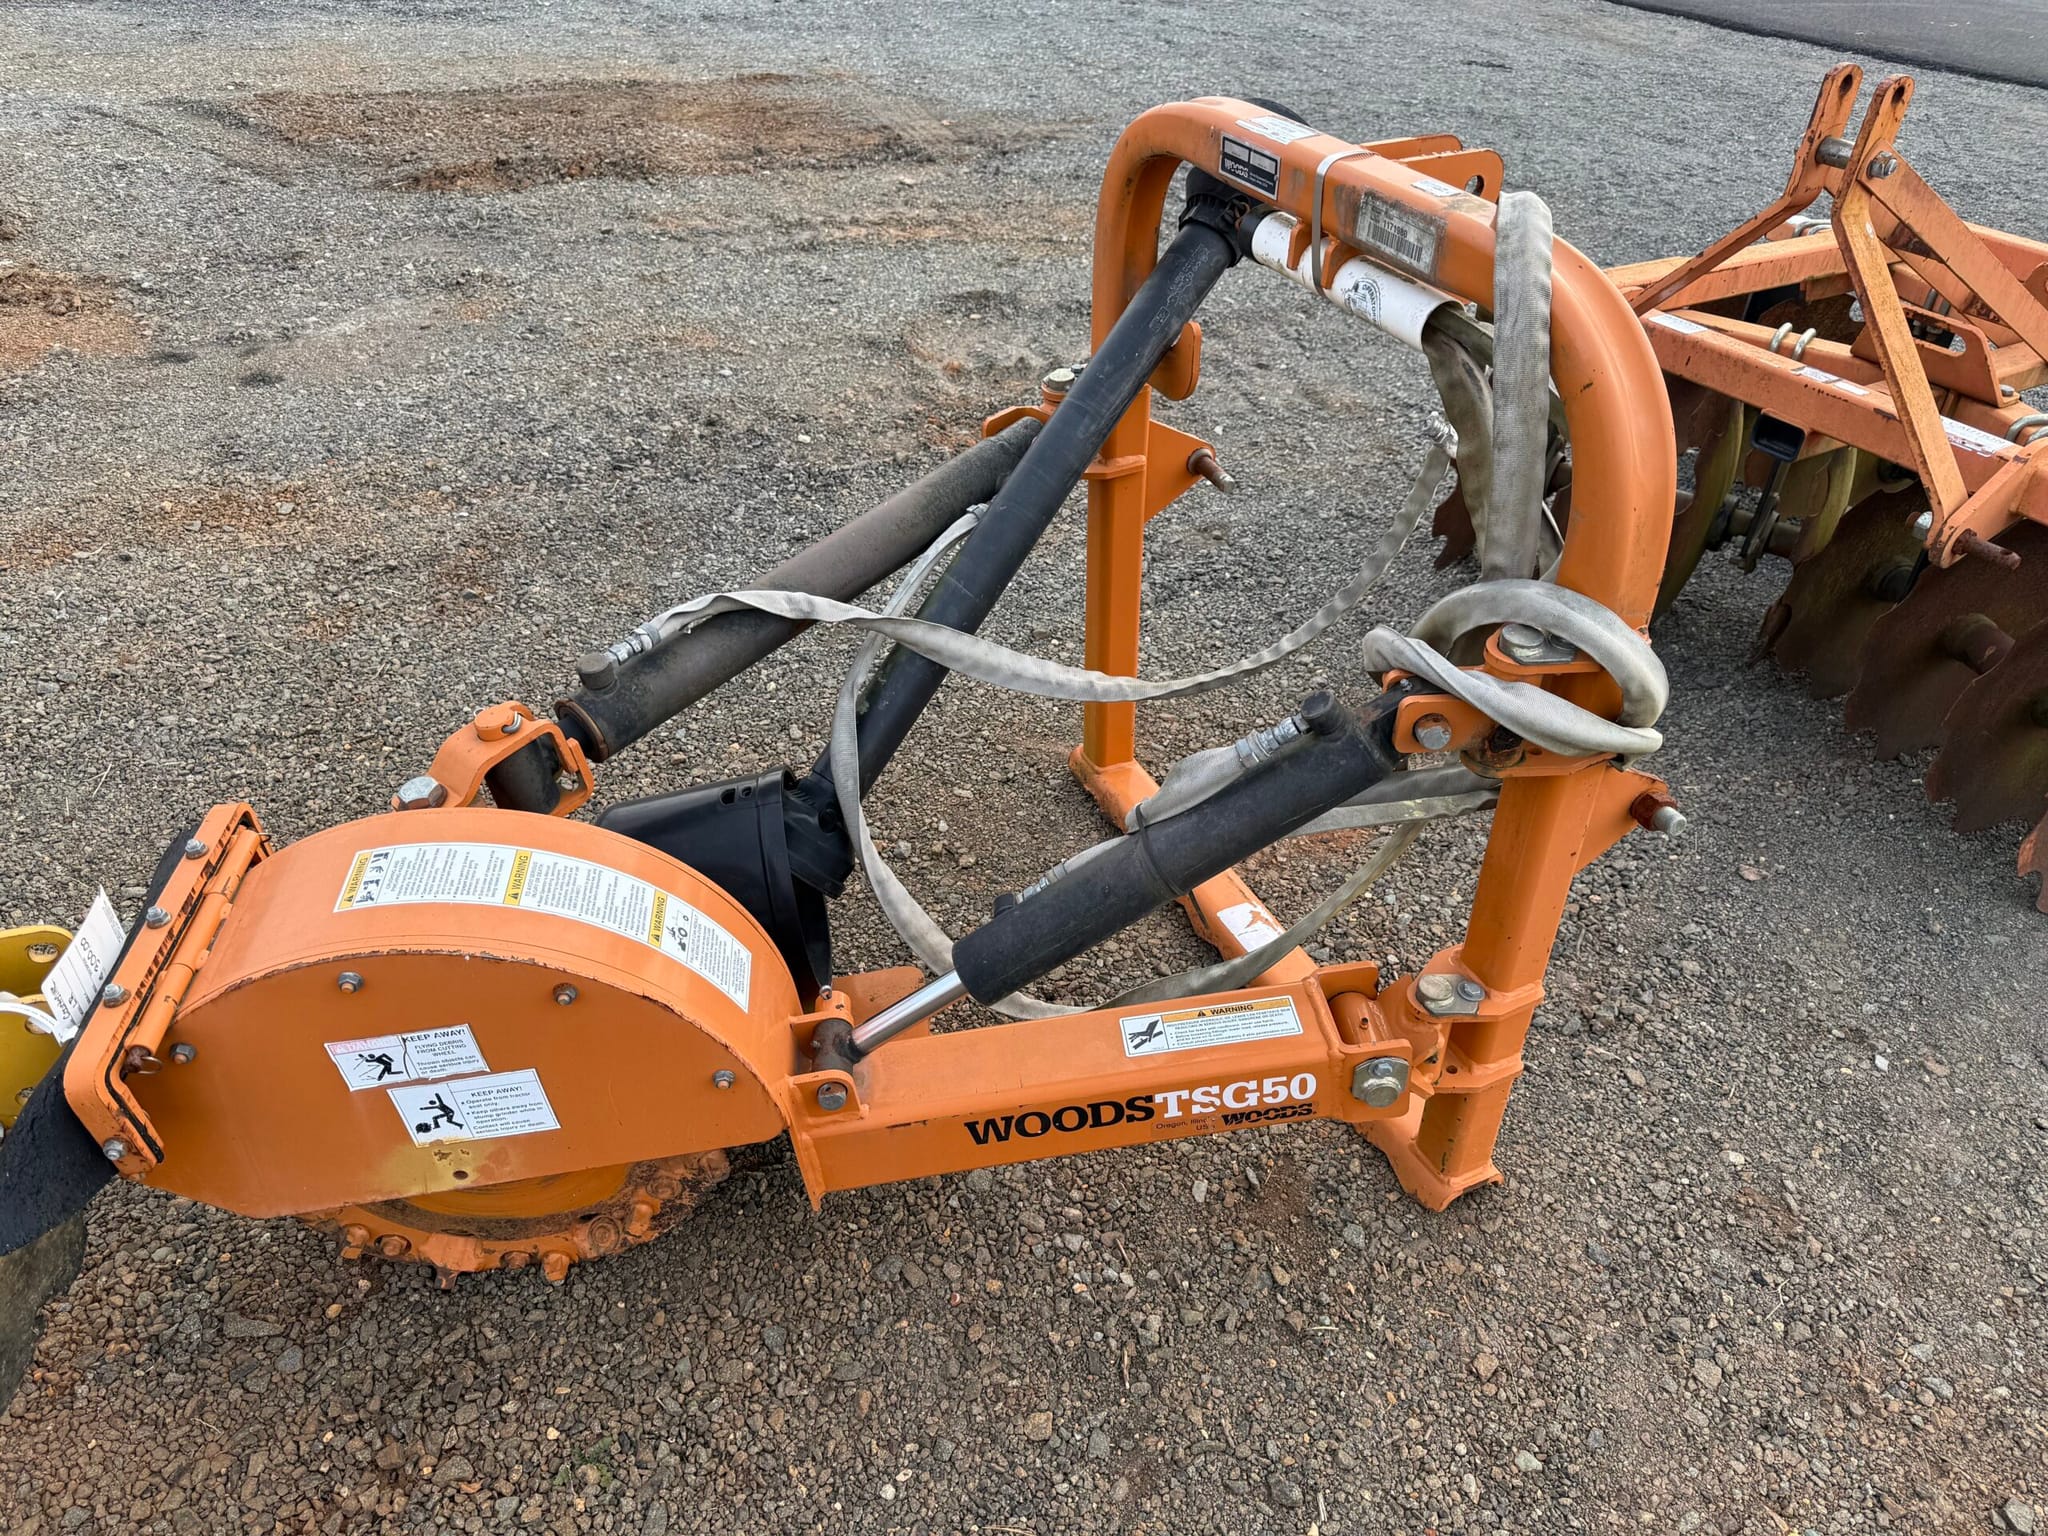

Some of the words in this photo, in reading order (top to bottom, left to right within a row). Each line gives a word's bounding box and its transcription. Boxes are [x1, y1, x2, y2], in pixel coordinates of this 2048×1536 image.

[511, 855, 528, 890] WARNING
[653, 895, 665, 933] WARNING
[1210, 1004, 1254, 1016] WARNING
[402, 1034, 431, 1043] KEEP
[433, 1029, 466, 1039] AWAY!
[495, 1086, 523, 1094] AWAY!
[964, 1095, 1154, 1145] WOODS
[1154, 1073, 1317, 1119] TSG50
[1221, 1103, 1312, 1125] WOODS
